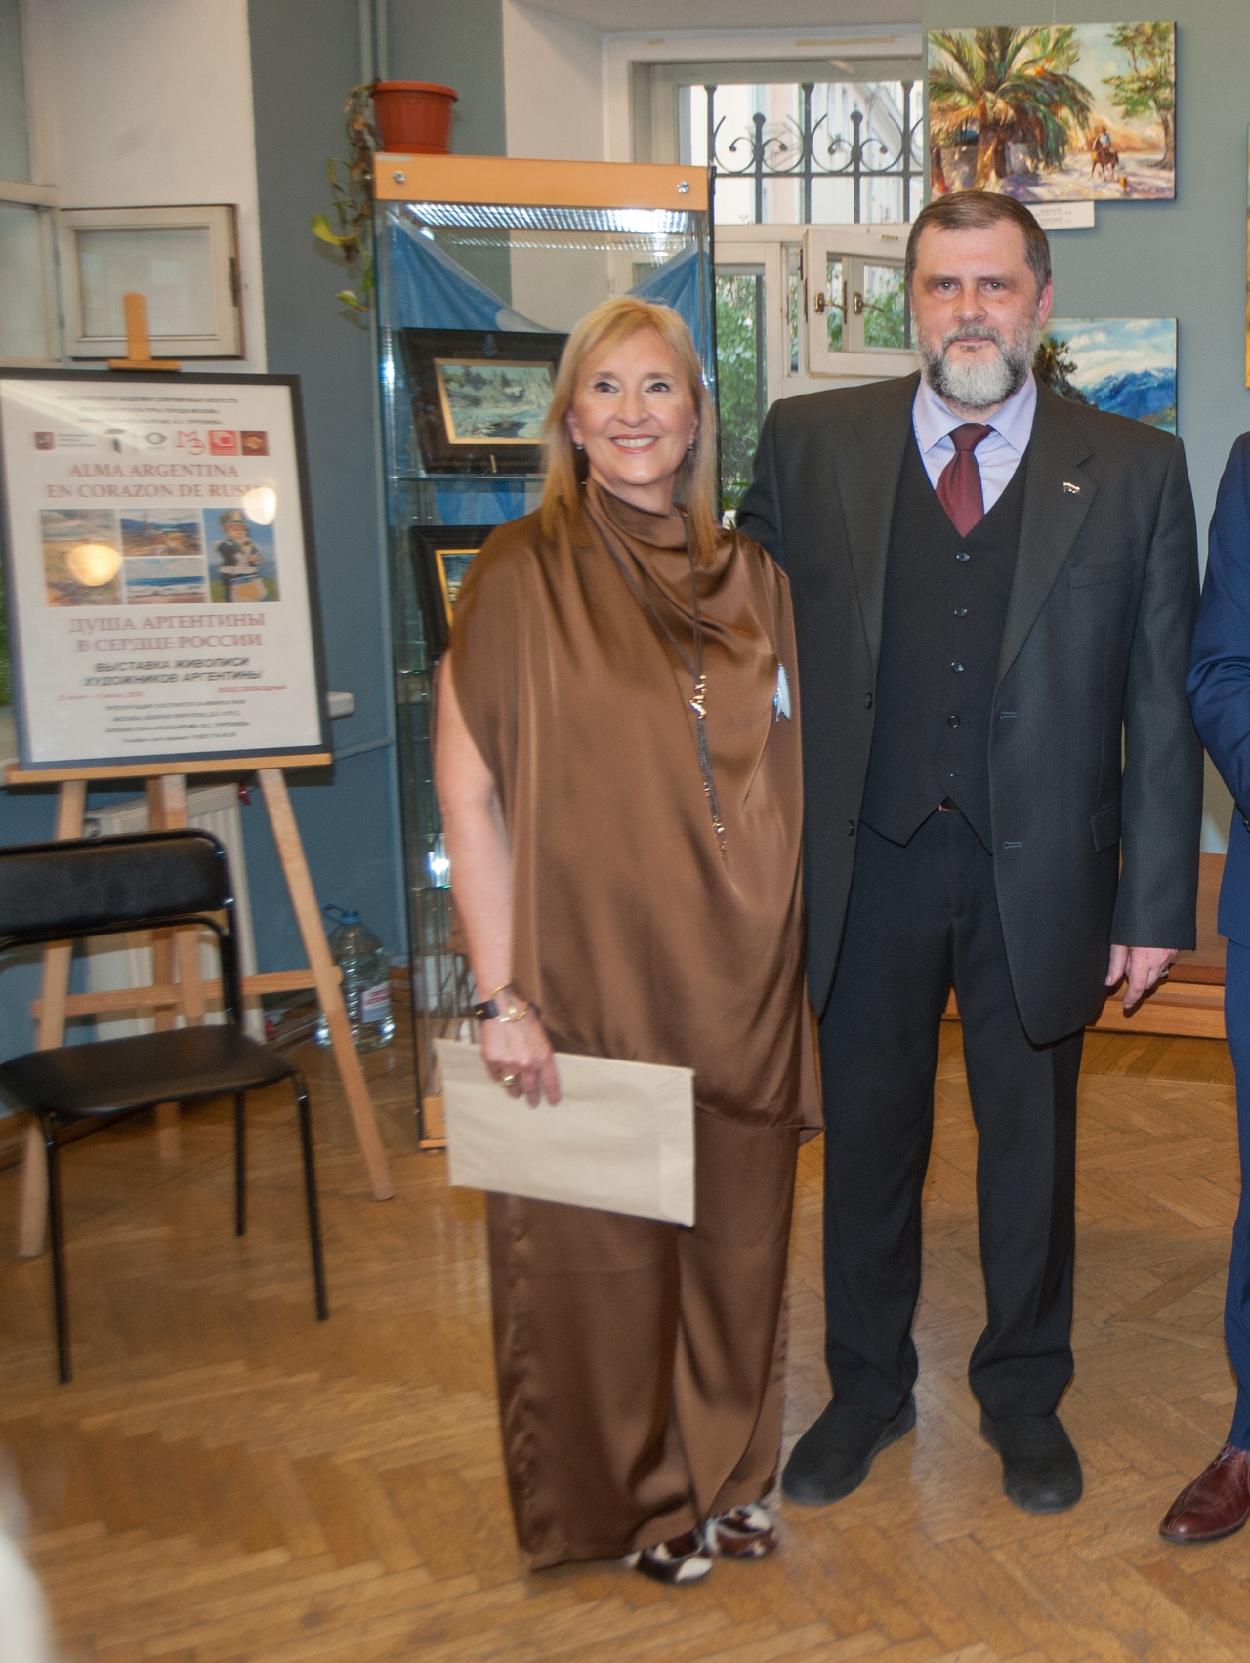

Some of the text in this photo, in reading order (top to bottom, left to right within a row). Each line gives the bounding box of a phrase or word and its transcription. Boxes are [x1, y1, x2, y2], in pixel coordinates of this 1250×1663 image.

[69, 463, 239, 477] ALMA ARGENTINA
[47, 484, 73, 497] EN
[78, 484, 173, 497] CORAZON
[179, 484, 204, 497] DE
[69, 613, 266, 634] ДУША АРГЕНТИНЫ
[76, 634, 264, 651] В СЕРДЦЕ РОССИИ
[96, 661, 170, 672] ВЫСТАВКА
[182, 671, 264, 682] АРГЕНТИНЫ
